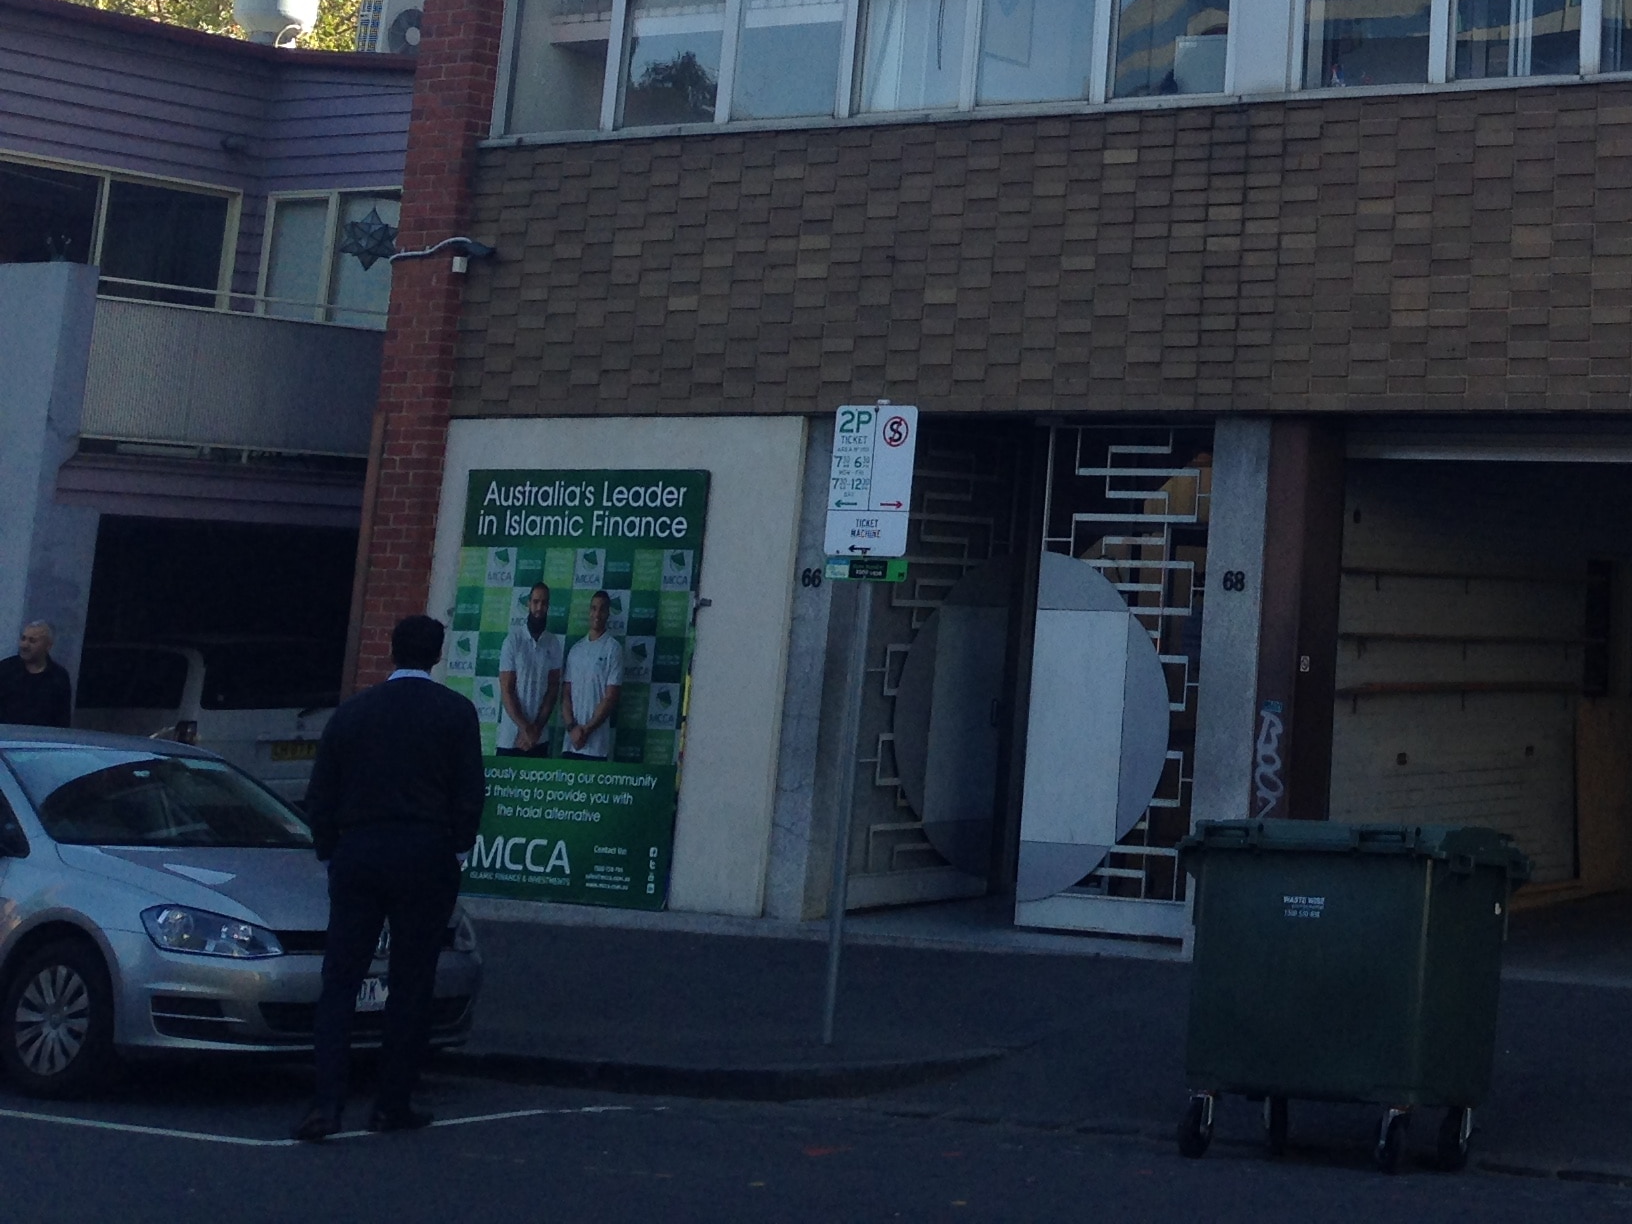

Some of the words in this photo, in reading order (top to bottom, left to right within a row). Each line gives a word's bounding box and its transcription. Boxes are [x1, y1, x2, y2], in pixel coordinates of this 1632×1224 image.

[839, 410, 872, 434] 2P
[841, 435, 868, 445] TICKET
[484, 481, 594, 507] Australia's
[602, 481, 687, 507] Leader
[478, 510, 497, 536] in
[505, 510, 583, 536] Islamic
[592, 510, 688, 537] Finance
[855, 519, 879, 528] TICKET
[850, 529, 881, 538] MACHINE
[801, 568, 821, 587] 66
[1223, 571, 1245, 592] 68
[519, 769, 574, 786] supporting
[577, 773, 595, 784] our
[597, 774, 658, 789] community
[494, 786, 530, 801] thriving
[534, 788, 544, 799] to
[546, 790, 586, 802] provide
[590, 794, 609, 805] you
[612, 792, 633, 805] with
[497, 804, 513, 817] the
[516, 805, 542, 818] halal
[545, 806, 600, 822] alternative
[471, 834, 570, 874] MCCA
